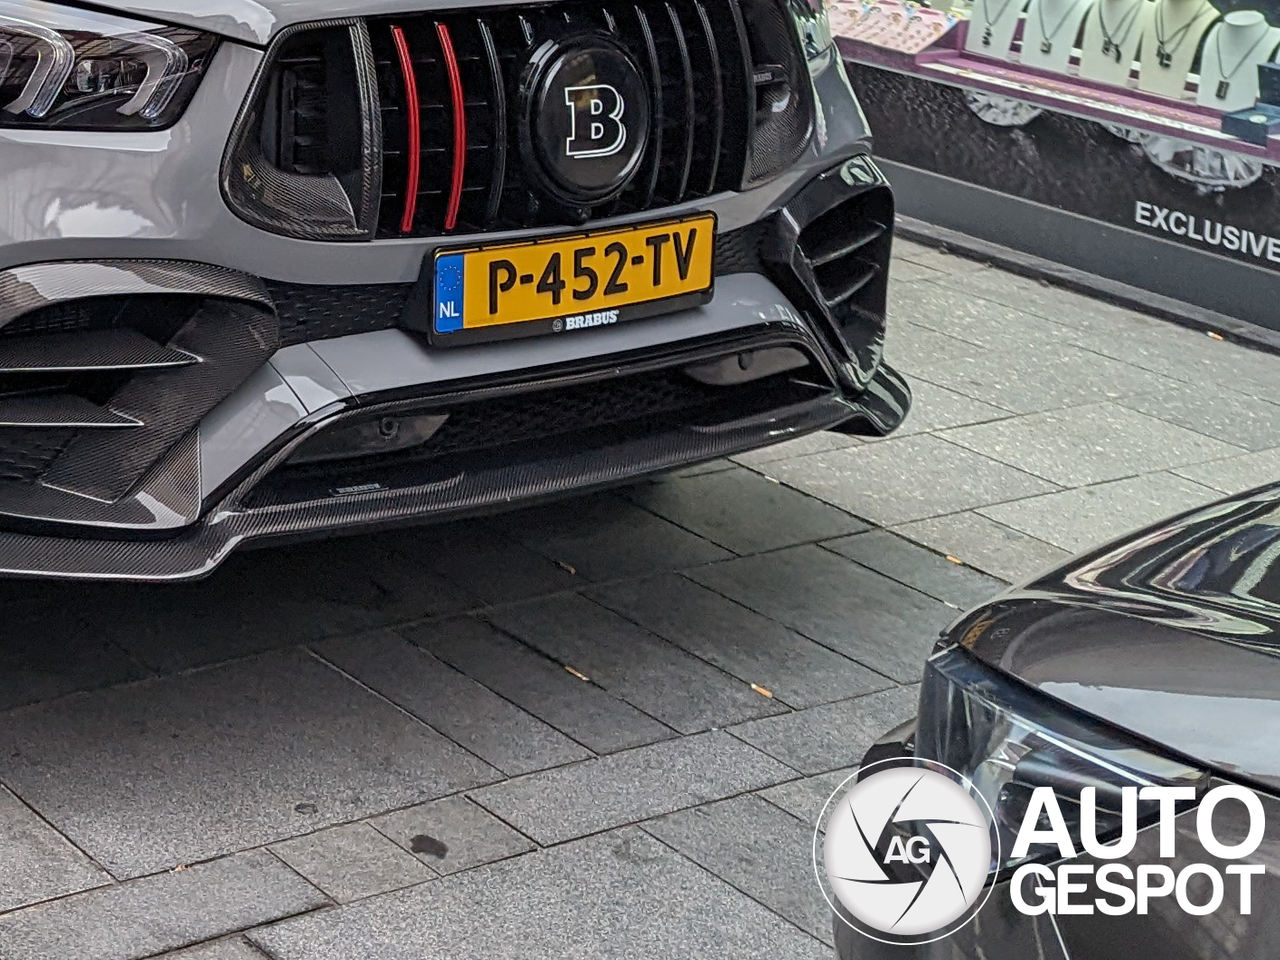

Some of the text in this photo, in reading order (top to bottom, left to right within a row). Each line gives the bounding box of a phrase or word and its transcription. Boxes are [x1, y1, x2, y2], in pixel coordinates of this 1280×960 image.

[565, 84, 627, 159] B
[1135, 200, 1280, 263] EXCLUSIVE
[488, 228, 698, 315] P-452-TV
[439, 300, 460, 319] NL
